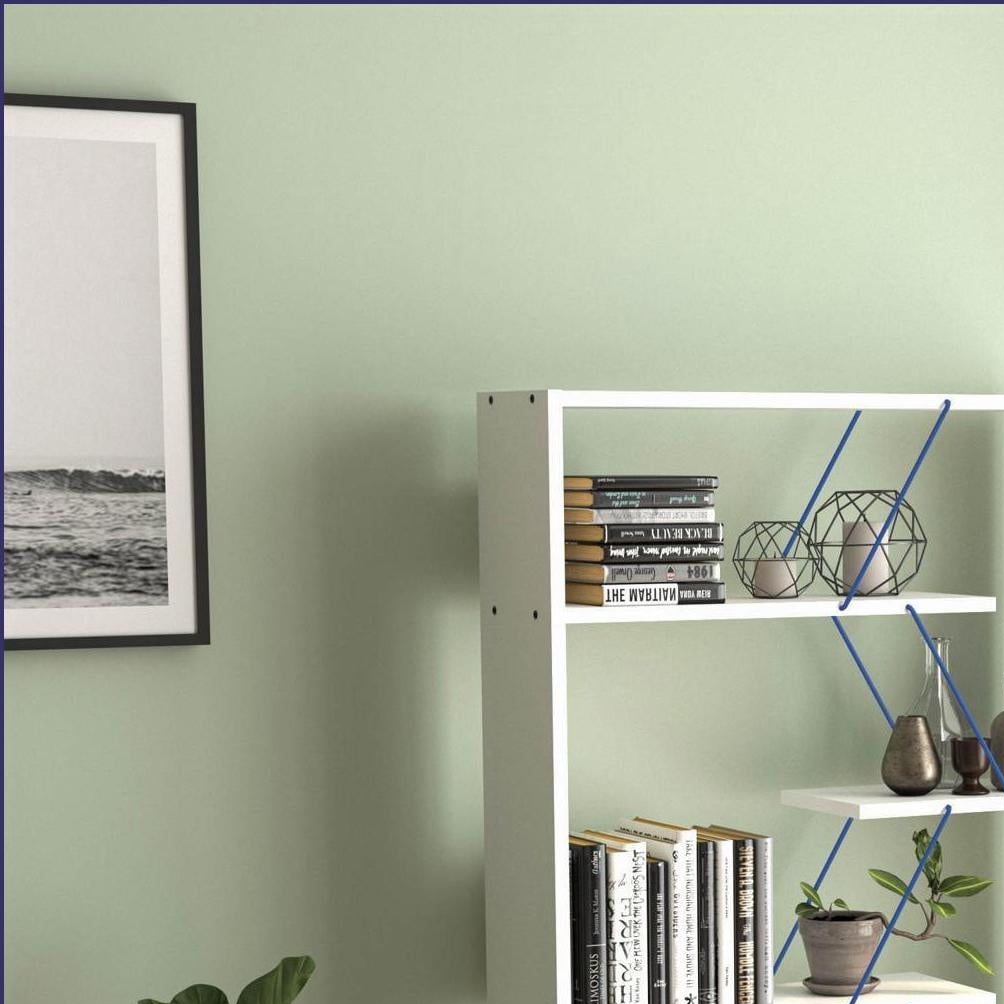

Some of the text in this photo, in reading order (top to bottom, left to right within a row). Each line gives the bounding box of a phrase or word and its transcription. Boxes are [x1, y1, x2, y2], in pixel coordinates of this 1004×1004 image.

[651, 527, 712, 539] BLACK BEAUTY
[611, 565, 656, 581] George Orwell
[687, 566, 713, 579] 1984
[738, 846, 754, 877] STEVEN
[738, 889, 754, 918] BROWN
